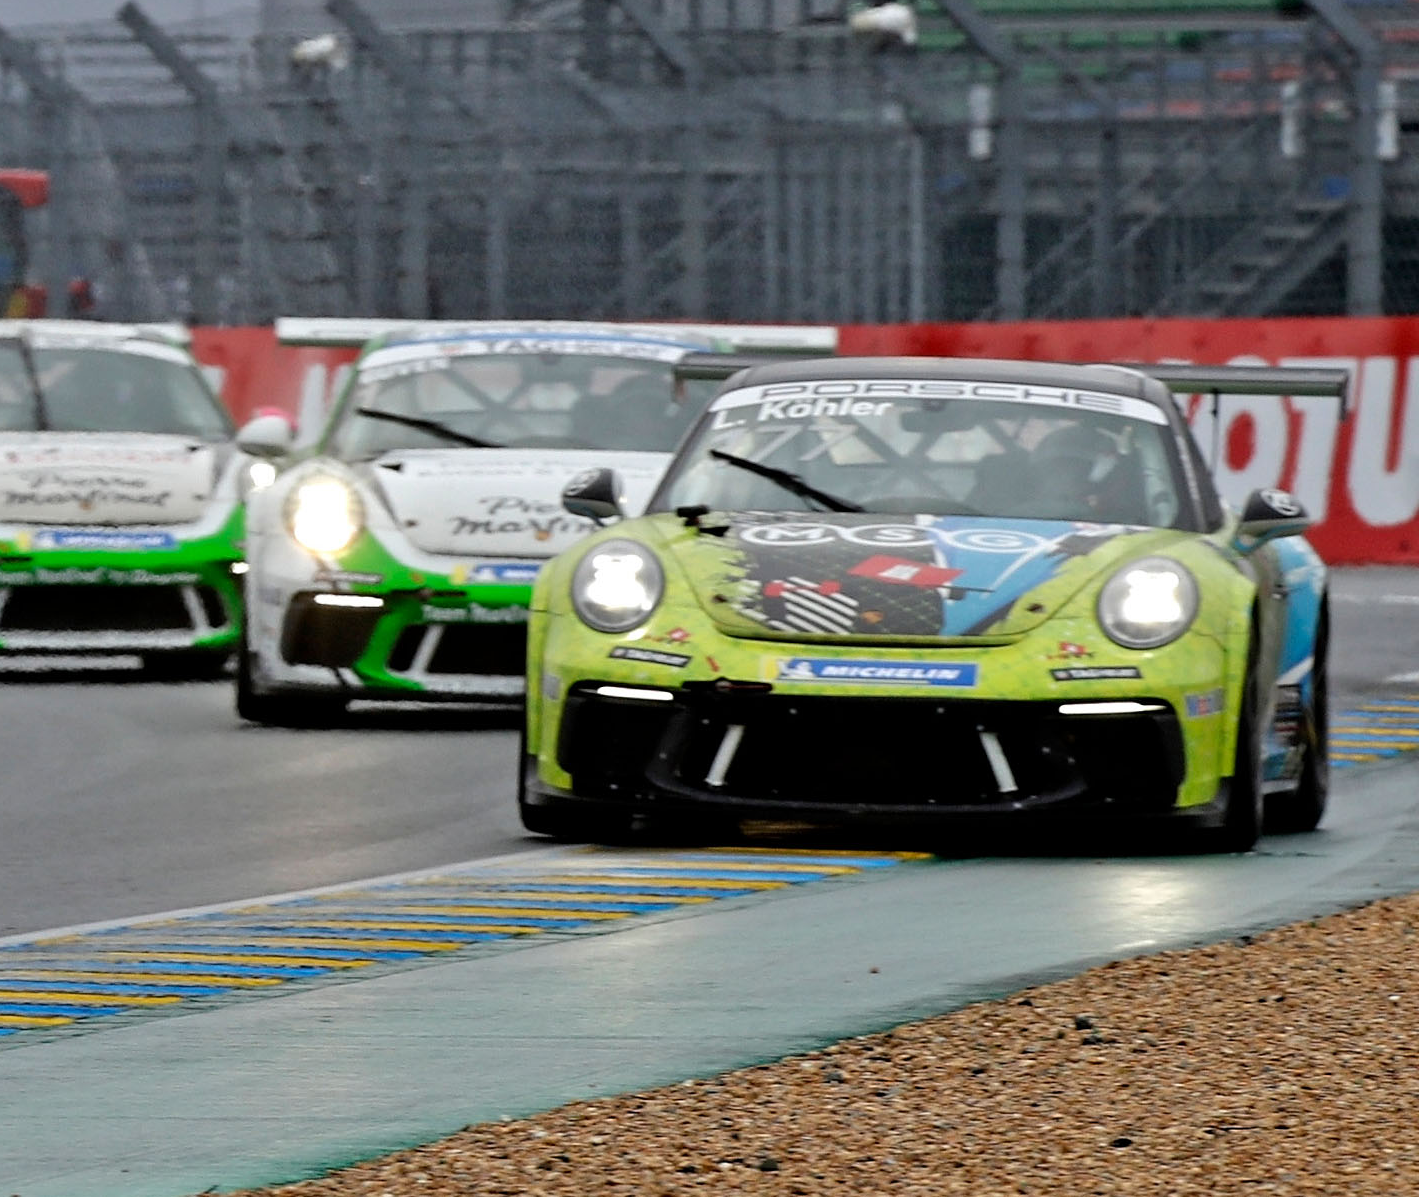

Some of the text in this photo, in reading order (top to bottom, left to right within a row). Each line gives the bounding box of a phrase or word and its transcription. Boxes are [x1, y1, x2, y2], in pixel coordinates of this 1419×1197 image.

[761, 381, 1125, 412] PORSCHE
[711, 397, 893, 430] L. Köhler
[821, 664, 961, 681] MICHELIN
